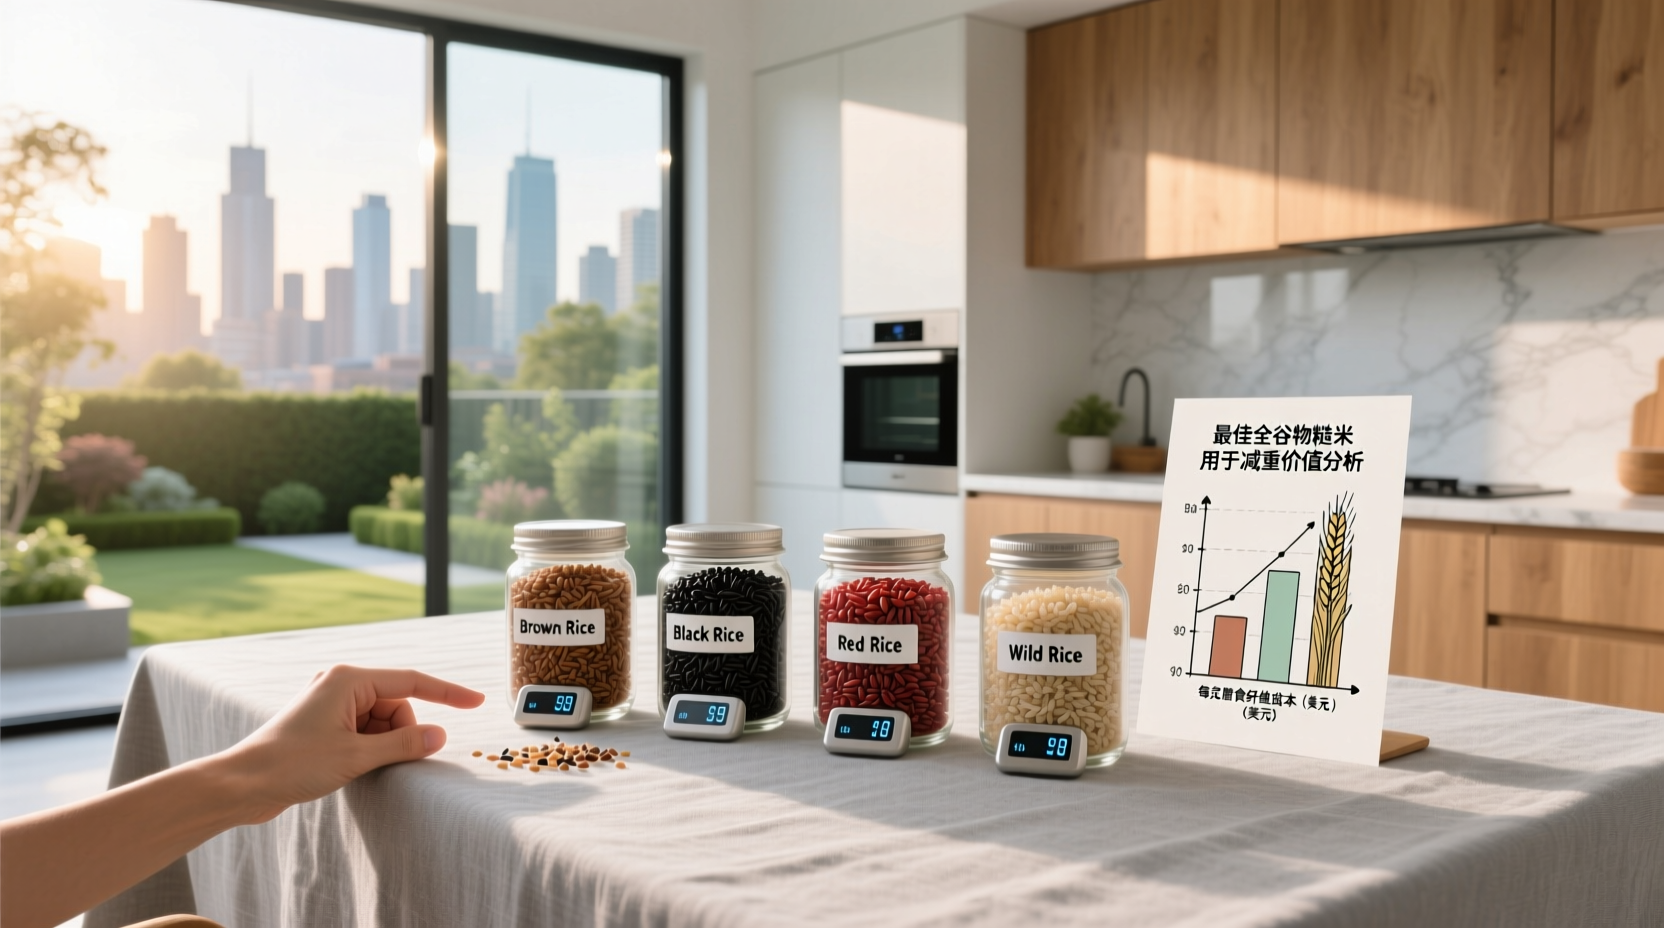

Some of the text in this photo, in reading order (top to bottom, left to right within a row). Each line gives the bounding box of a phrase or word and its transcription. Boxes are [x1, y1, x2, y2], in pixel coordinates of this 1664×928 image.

[1212, 423, 1354, 447] 最佳全谷物糙米
[1199, 449, 1365, 473] 用于减重价值分析
[520, 619, 596, 635] Brown Rice
[673, 624, 745, 643] Black Rice
[838, 634, 903, 653] Red Rice
[1008, 644, 1083, 664] Wild Rice
